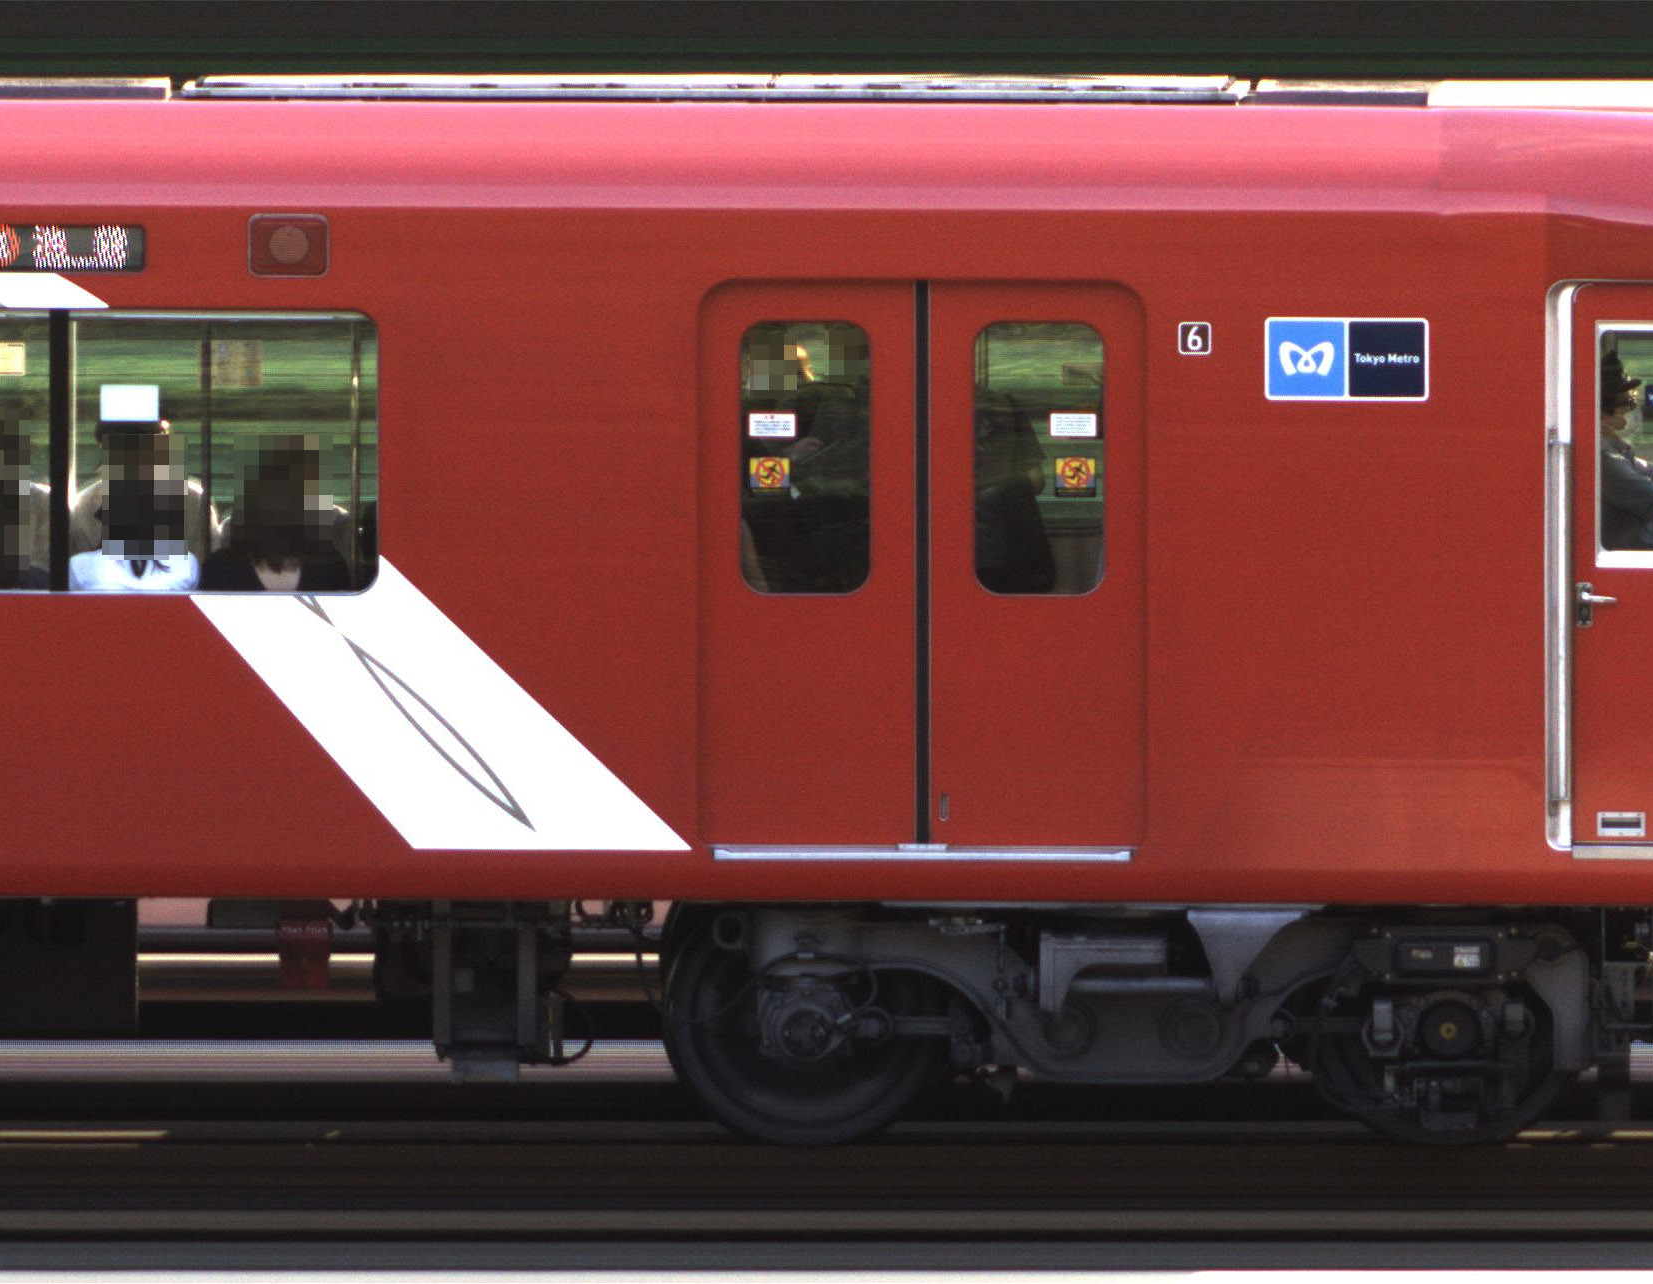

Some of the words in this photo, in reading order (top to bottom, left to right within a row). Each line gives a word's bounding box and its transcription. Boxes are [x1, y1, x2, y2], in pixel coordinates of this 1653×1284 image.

[1187, 326, 1202, 351] 6
[1354, 352, 1385, 365] Tokyo
[1388, 353, 1420, 363] Metro
